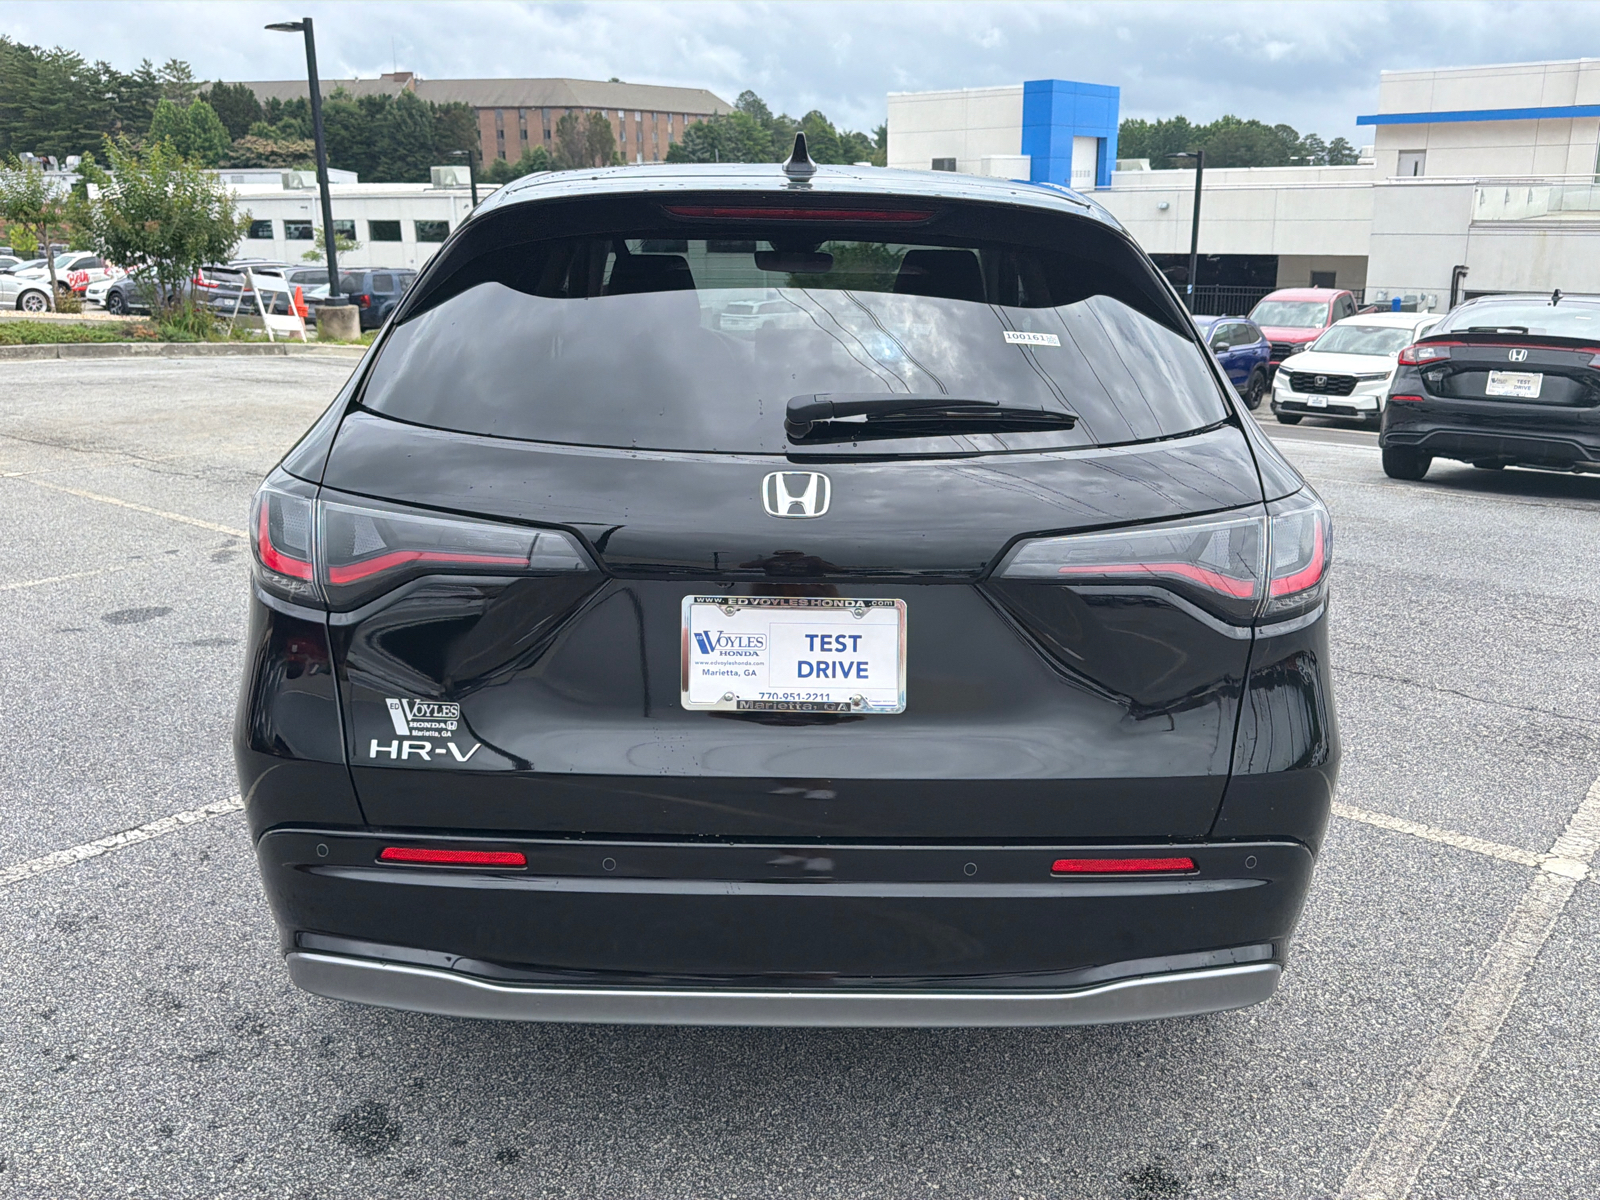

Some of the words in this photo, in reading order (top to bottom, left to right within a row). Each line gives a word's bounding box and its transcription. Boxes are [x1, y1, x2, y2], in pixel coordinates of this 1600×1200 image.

[1005, 333, 1046, 342] 100161
[702, 630, 764, 653] VOYLES
[804, 634, 863, 653] TEST
[702, 668, 741, 677] Marietta,
[743, 669, 757, 677] GA
[797, 660, 869, 679] DRIVE
[758, 692, 831, 701] 770-951-2211
[389, 702, 400, 710] ED
[401, 698, 458, 721] VOYLES
[739, 700, 818, 711] Marietta,
[823, 701, 849, 711] GA
[412, 730, 441, 738] Marietta,
[369, 739, 482, 762] HR-V
